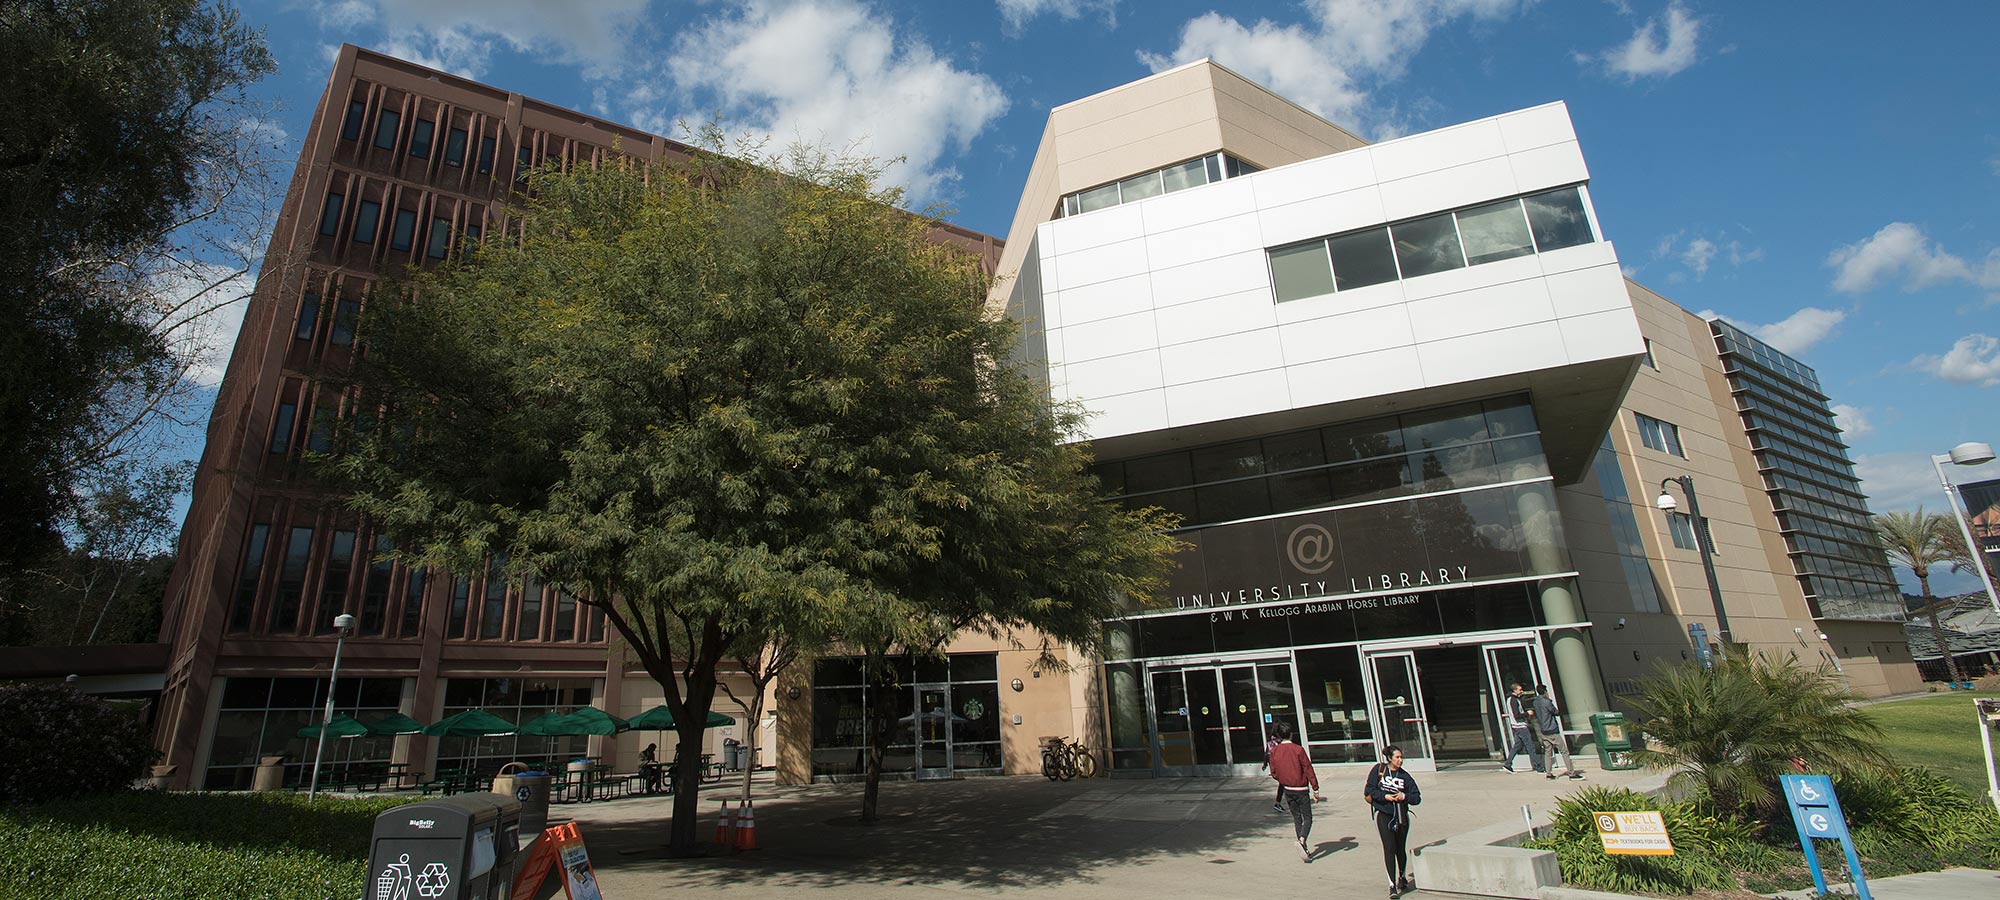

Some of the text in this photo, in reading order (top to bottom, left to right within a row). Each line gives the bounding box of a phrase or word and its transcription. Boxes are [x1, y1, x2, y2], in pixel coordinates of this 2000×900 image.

[1287, 524, 1333, 574] @
[1177, 566, 1467, 610] UNIVERSITY LIBRARY
[1223, 611, 1233, 621] W
[1241, 609, 1249, 620] K
[1259, 606, 1300, 618] KELLOGG
[1305, 602, 1342, 614] ARABIAN
[1347, 598, 1378, 610] HORSE
[1383, 595, 1420, 607] LIBRARY
[1620, 815, 1656, 825] WE'LL
